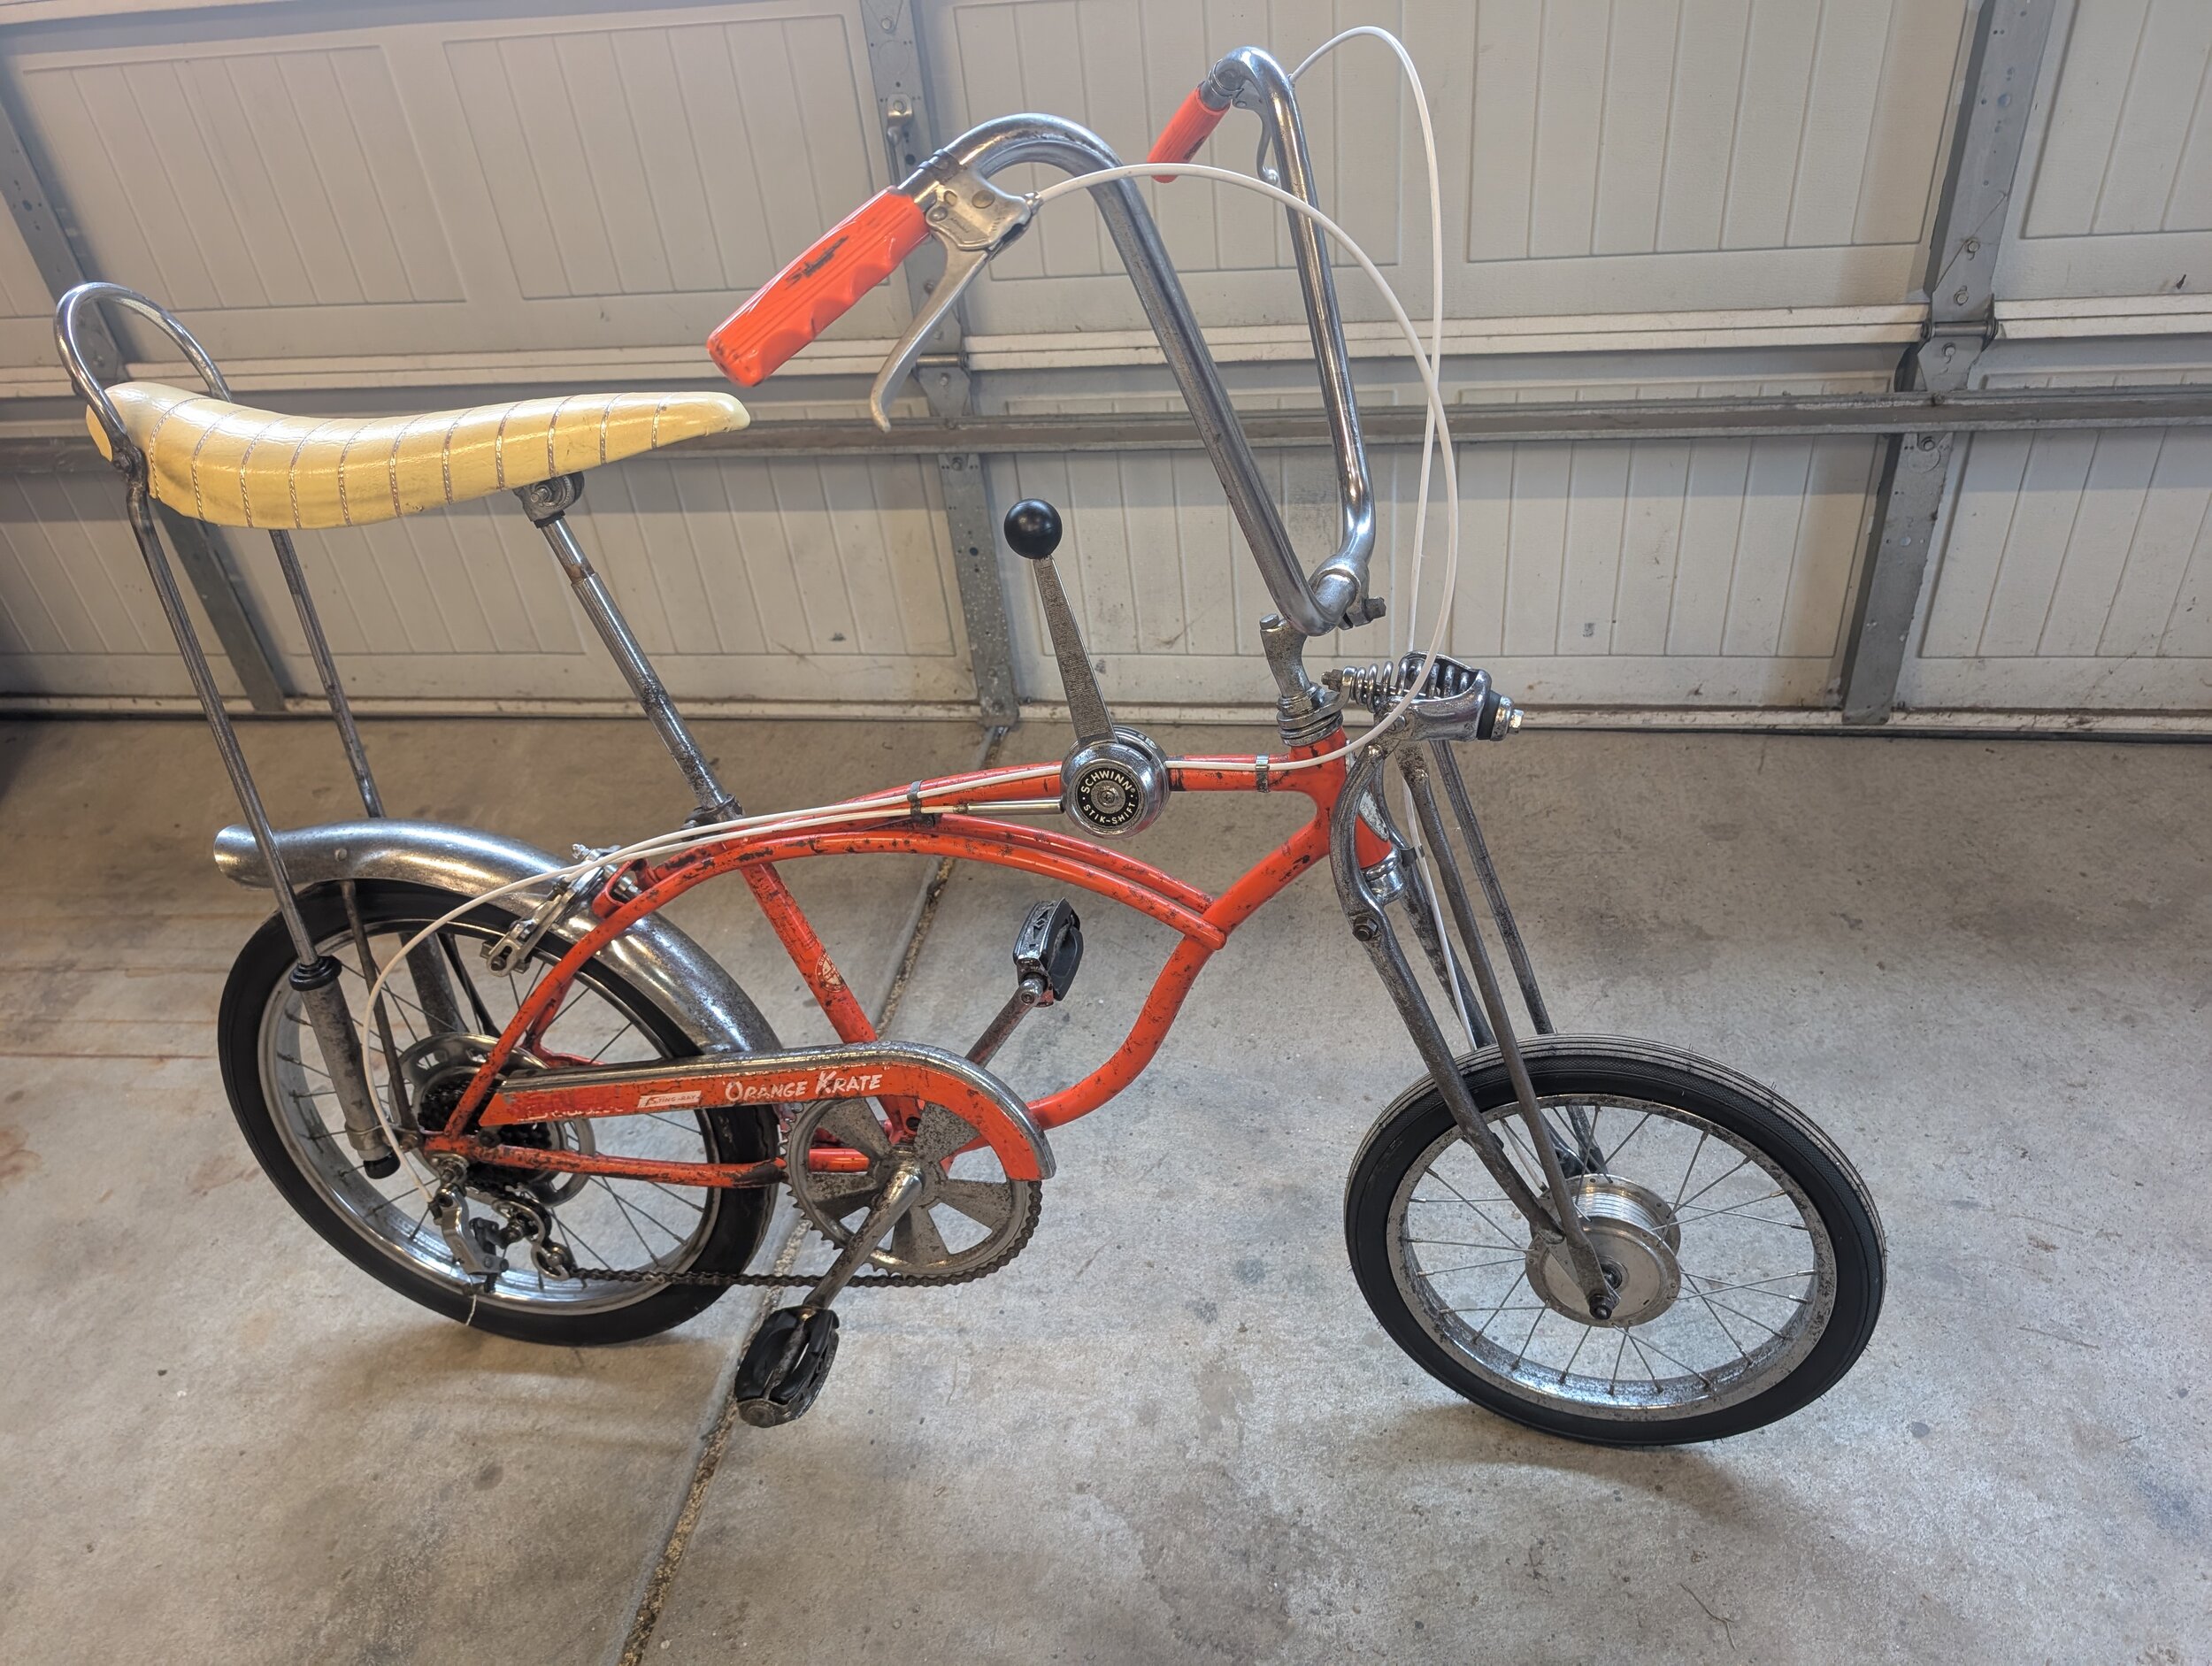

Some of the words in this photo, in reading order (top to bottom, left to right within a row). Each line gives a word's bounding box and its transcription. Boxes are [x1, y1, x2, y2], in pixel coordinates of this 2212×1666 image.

[1083, 802, 1136, 825] STIK-SHIFT
[724, 1080, 808, 1102] ORANGE
[815, 1070, 883, 1094] KRATE
